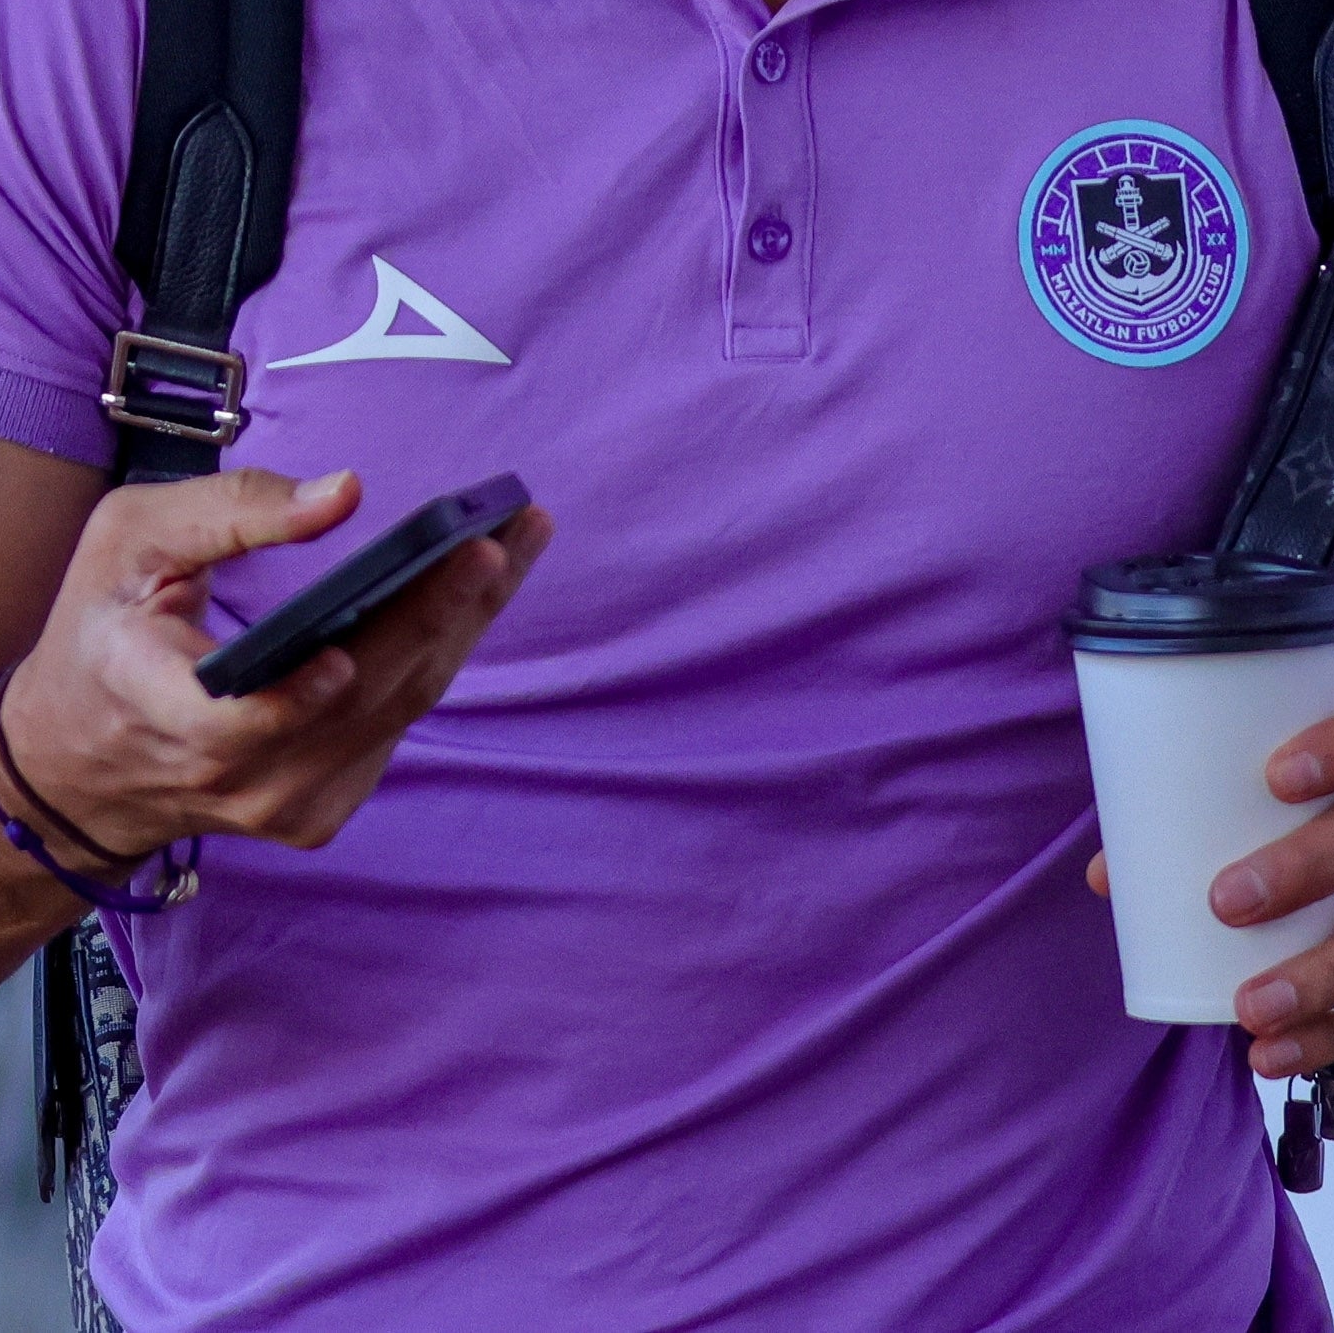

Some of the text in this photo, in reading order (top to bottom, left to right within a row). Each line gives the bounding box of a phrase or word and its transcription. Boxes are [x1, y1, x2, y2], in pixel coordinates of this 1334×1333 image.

[1205, 232, 1227, 247] XX
[1040, 244, 1067, 257] MM
[1050, 262, 1224, 341] MAZATLAN FUTBOL CLUB
